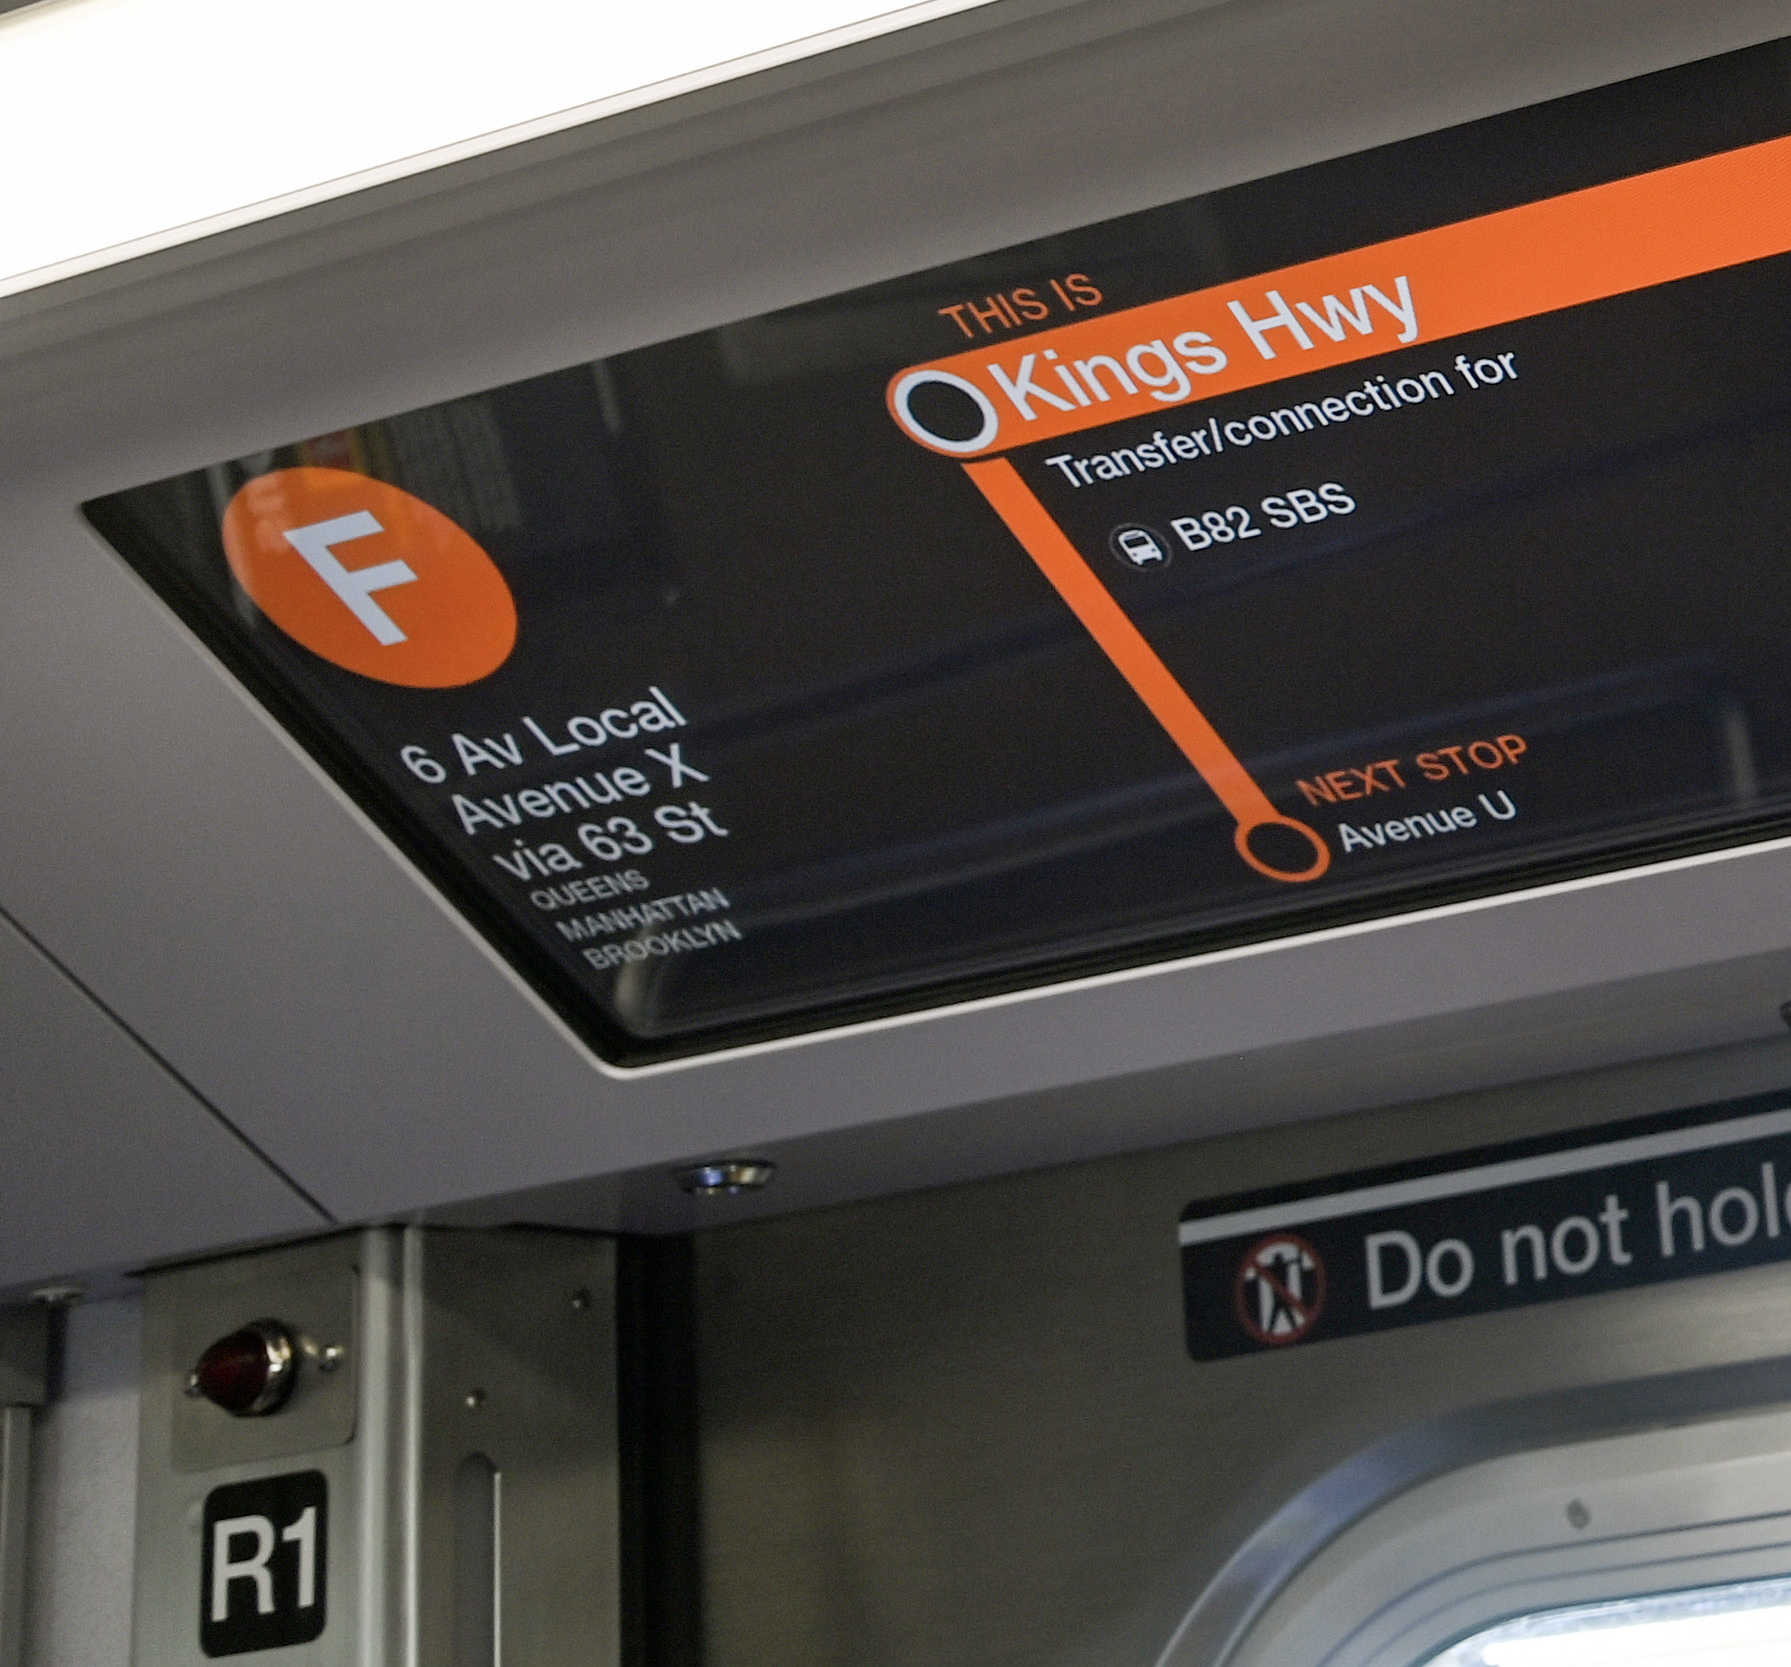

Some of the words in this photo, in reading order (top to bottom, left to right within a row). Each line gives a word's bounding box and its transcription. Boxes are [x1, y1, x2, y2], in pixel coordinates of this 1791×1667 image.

[938, 285, 1050, 339] THIS
[1053, 272, 1105, 312] IS
[987, 332, 1229, 423] Kings
[1227, 274, 1423, 360] Hwy
[1046, 360, 1455, 491] Transfer/connection
[1454, 346, 1520, 390] for
[1170, 504, 1261, 554] B82
[1259, 481, 1357, 531] SBS
[283, 510, 419, 647] F
[401, 747, 448, 784] 6
[451, 731, 524, 777] Av
[522, 686, 688, 757] Local
[1297, 758, 1408, 808] NEXT
[1417, 732, 1529, 781] STOP
[450, 761, 651, 835] Avenue
[644, 742, 710, 789] X
[1337, 793, 1478, 855] Avenue
[1476, 788, 1518, 824] U
[493, 835, 583, 883] via
[577, 815, 651, 860] 63
[653, 801, 730, 850] St
[529, 869, 651, 911] QUEENS
[554, 887, 731, 945] MANHATTAN
[583, 919, 743, 972] BROOKLYN
[1364, 1229, 1475, 1311] Do
[1500, 1196, 1631, 1285] not
[210, 1505, 317, 1623] R1
